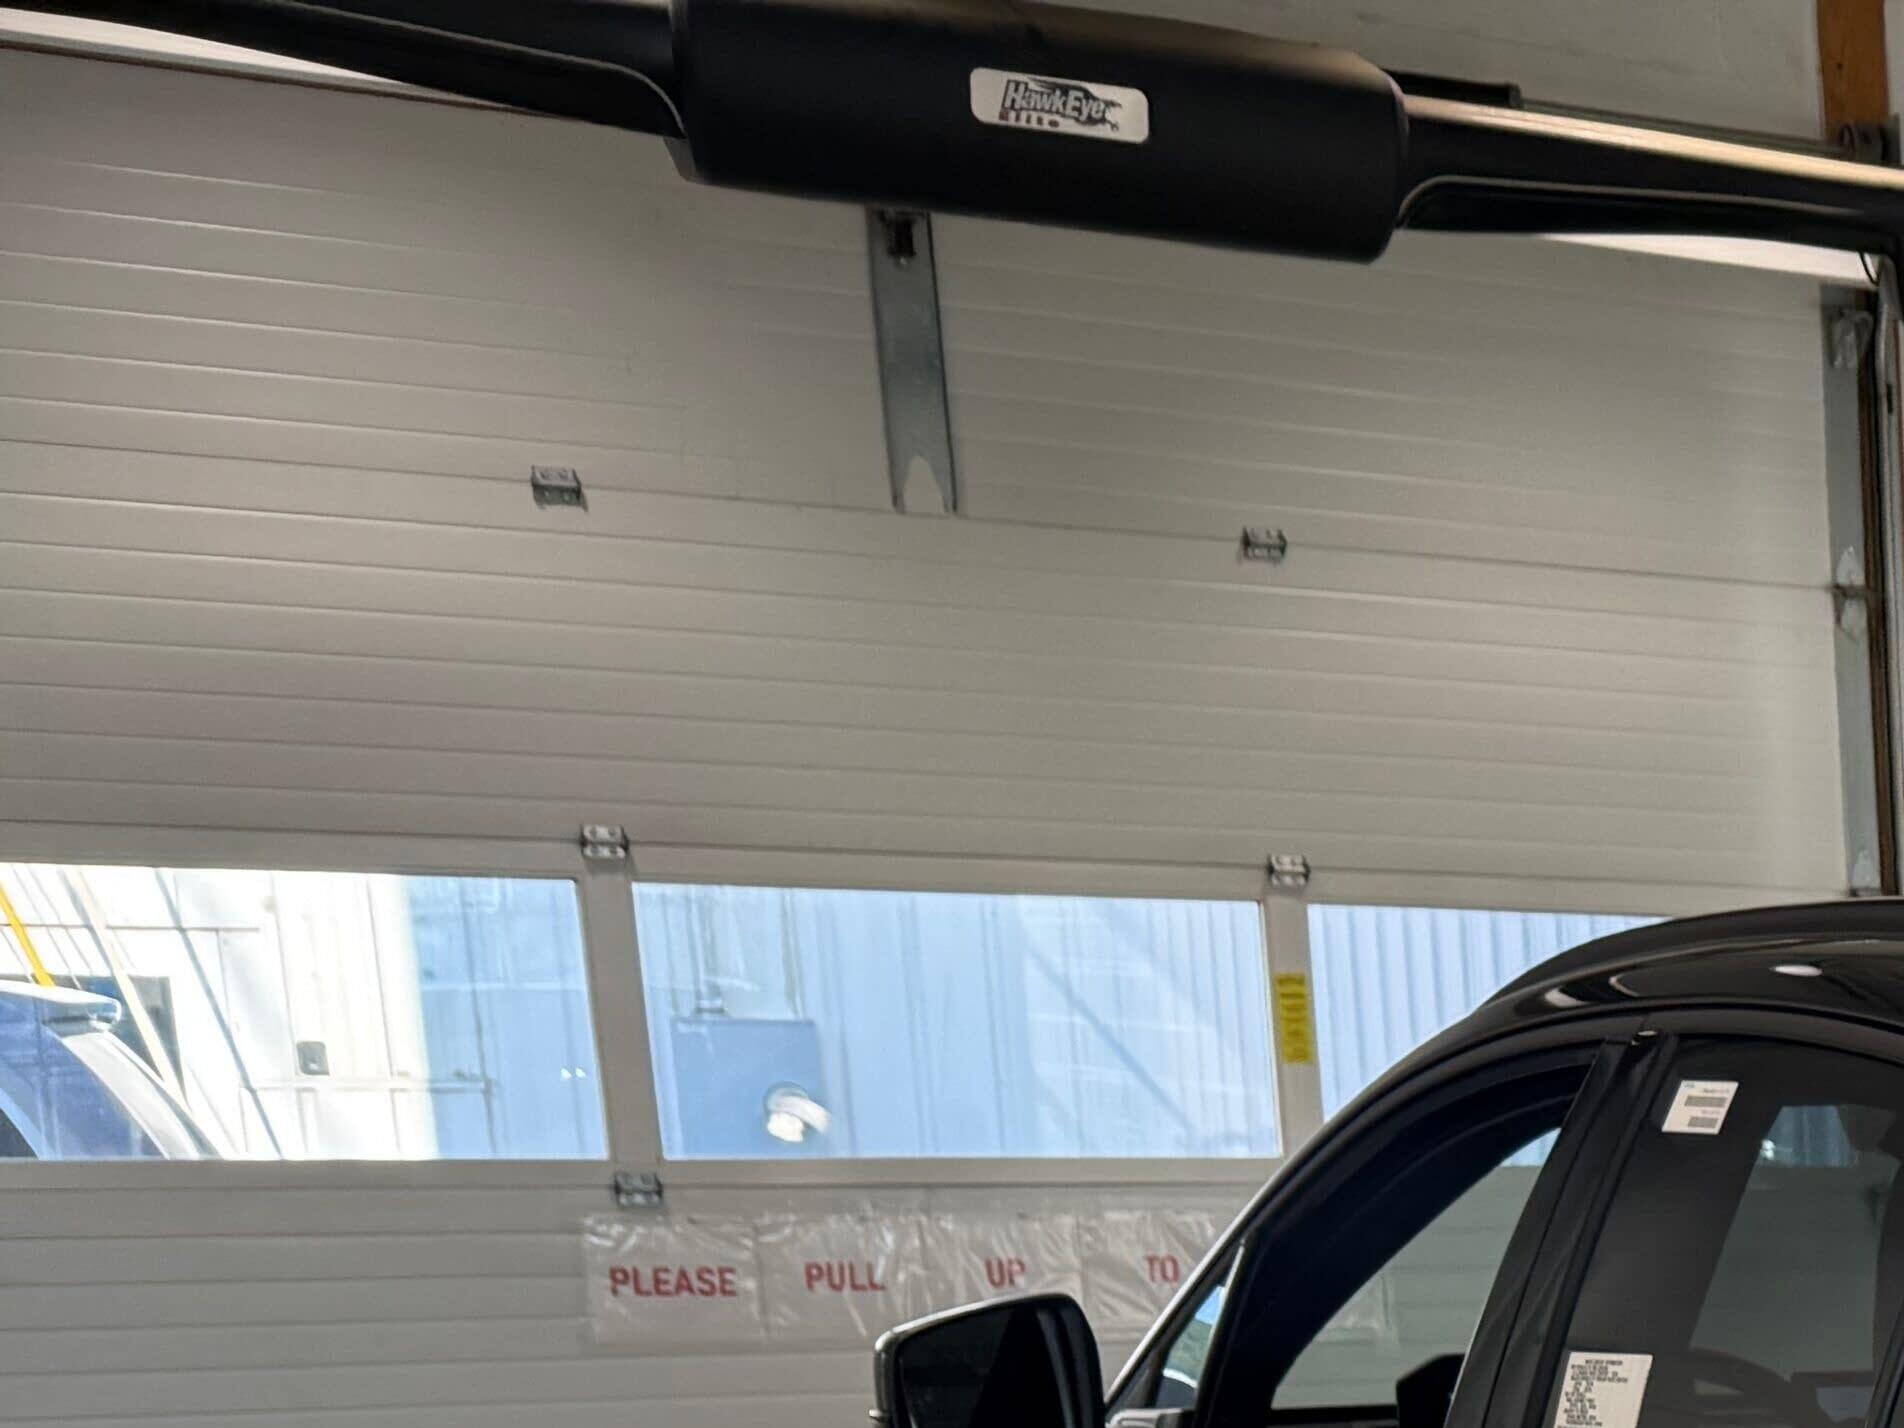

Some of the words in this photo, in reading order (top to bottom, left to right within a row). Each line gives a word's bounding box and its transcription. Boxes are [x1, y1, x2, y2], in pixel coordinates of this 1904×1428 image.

[1002, 80, 1106, 121] HawkEye
[609, 1265, 738, 1299] PLEASE
[805, 1261, 886, 1294] PULL
[985, 1257, 1027, 1288] UP
[1146, 1254, 1181, 1285] TO
